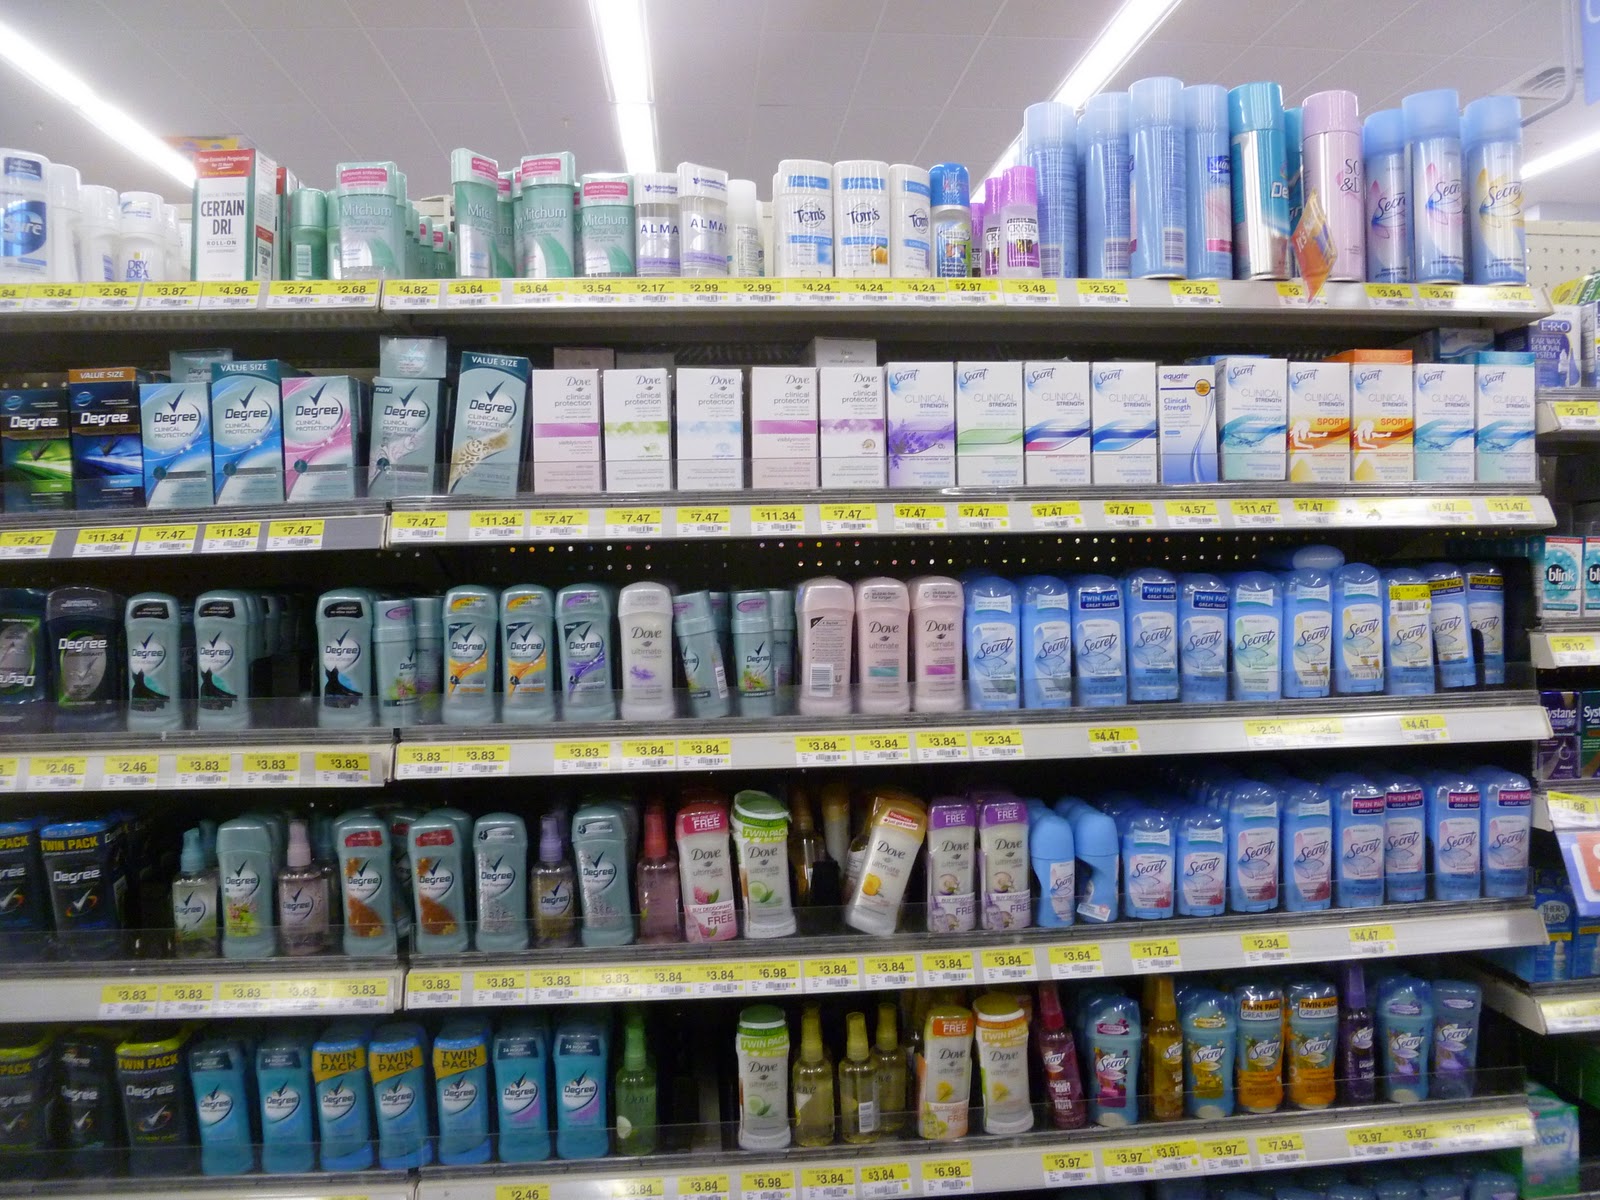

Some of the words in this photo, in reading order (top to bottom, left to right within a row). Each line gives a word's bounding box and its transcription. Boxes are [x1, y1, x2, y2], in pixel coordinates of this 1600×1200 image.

[201, 200, 244, 217] CERTAIN
[342, 202, 392, 218] Mitchum
[583, 215, 628, 226] Mitchum
[213, 219, 231, 235] DRI
[128, 260, 148, 270] DRY
[126, 268, 149, 279] IDEA
[471, 356, 498, 365] VALUE
[500, 360, 518, 368] SIZE
[853, 372, 878, 383] Dove
[893, 368, 921, 386] Secret
[1163, 373, 1189, 381] equate
[1231, 364, 1256, 382] Secret
[1484, 371, 1506, 387] Secret
[566, 376, 592, 387] Dove
[710, 375, 735, 386] Dove
[564, 392, 591, 400] clinical
[625, 398, 662, 406] protection
[698, 398, 735, 406] protection
[773, 398, 810, 406] protection
[554, 399, 591, 407] protection
[1164, 404, 1191, 412] Strength
[296, 405, 339, 418] Degree
[384, 405, 426, 419] Degree
[10, 416, 59, 430] Degree
[154, 412, 198, 425] Degree
[1317, 418, 1345, 426] SPORT
[1380, 418, 1408, 426] SPORT
[1548, 567, 1575, 582] blink
[926, 619, 954, 632] Dove
[1349, 618, 1380, 640] Secret
[631, 626, 662, 639] Dove
[58, 638, 108, 652] Degree
[1084, 635, 1117, 656] Secret
[1190, 631, 1222, 651] Secret
[1241, 629, 1275, 651] Secret
[200, 647, 232, 658] Degree
[325, 645, 358, 656] Degree
[510, 641, 542, 652] Degree
[980, 637, 1013, 659] Secret
[997, 809, 1018, 820] FREE
[693, 817, 720, 828] FREE
[41, 840, 66, 851] TWIN
[67, 837, 99, 849] PACK
[994, 839, 1022, 850] Dove
[1387, 831, 1420, 850] Secret
[1446, 831, 1476, 852] Secret
[748, 846, 778, 858] Dove
[877, 840, 906, 860] Dove
[1301, 840, 1330, 862] Secret
[1133, 859, 1167, 877] Secret
[1187, 857, 1220, 877] Secret
[53, 868, 101, 884] Degree
[226, 876, 257, 887] Degree
[481, 872, 513, 882] Degree
[707, 914, 733, 926] FREE
[1243, 1003, 1261, 1011] TWIN
[943, 1023, 967, 1033] FREE
[1299, 1039, 1331, 1056] Secret
[1392, 1035, 1424, 1051] Secret
[320, 1051, 357, 1063] TWIN
[376, 1050, 414, 1063] TWIN
[939, 1048, 966, 1061] Dove
[990, 1050, 1018, 1062] Dove
[1195, 1047, 1225, 1063] Secret
[148, 1055, 178, 1069] PACK
[378, 1060, 416, 1072] PACK
[442, 1058, 479, 1069] PACK
[125, 1084, 175, 1098] Degree
[443, 1088, 474, 1099] Degree
[564, 1085, 597, 1095] Degree
[322, 1095, 354, 1105] Degree
